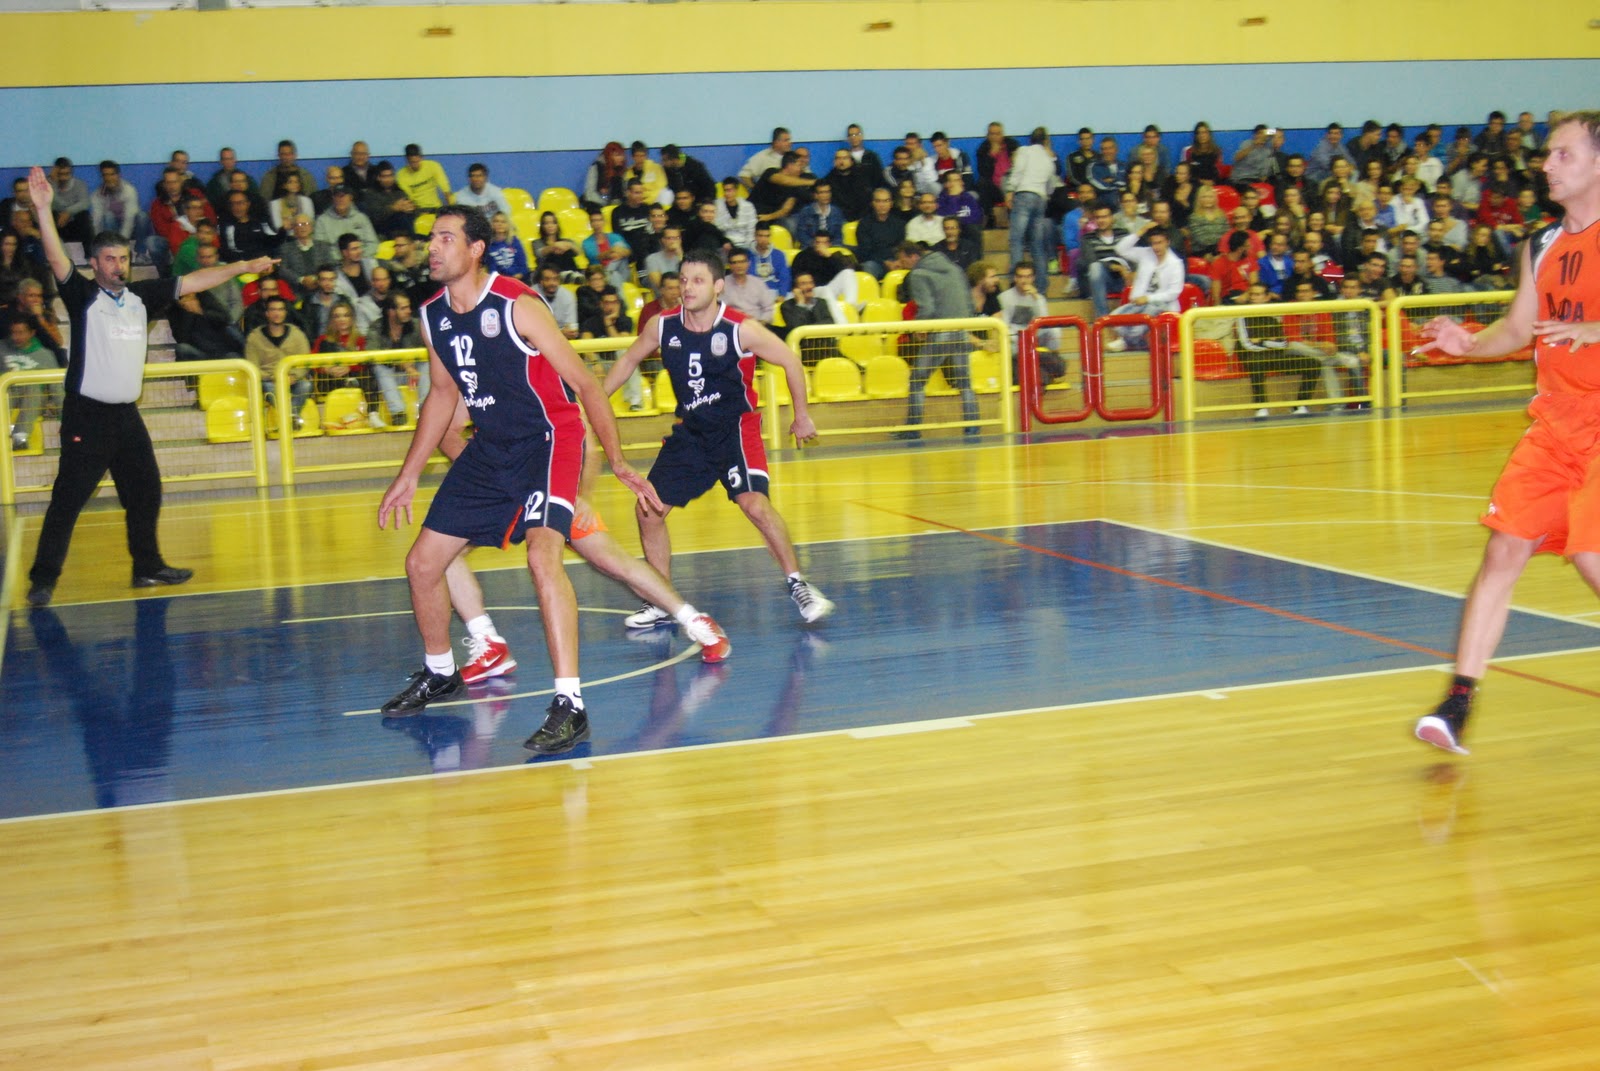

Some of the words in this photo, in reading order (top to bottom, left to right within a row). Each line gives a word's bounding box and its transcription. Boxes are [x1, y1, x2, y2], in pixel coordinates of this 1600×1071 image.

[1558, 250, 1583, 286] 10
[449, 335, 477, 367] 12
[688, 353, 702, 377] 5
[727, 465, 741, 488] 5
